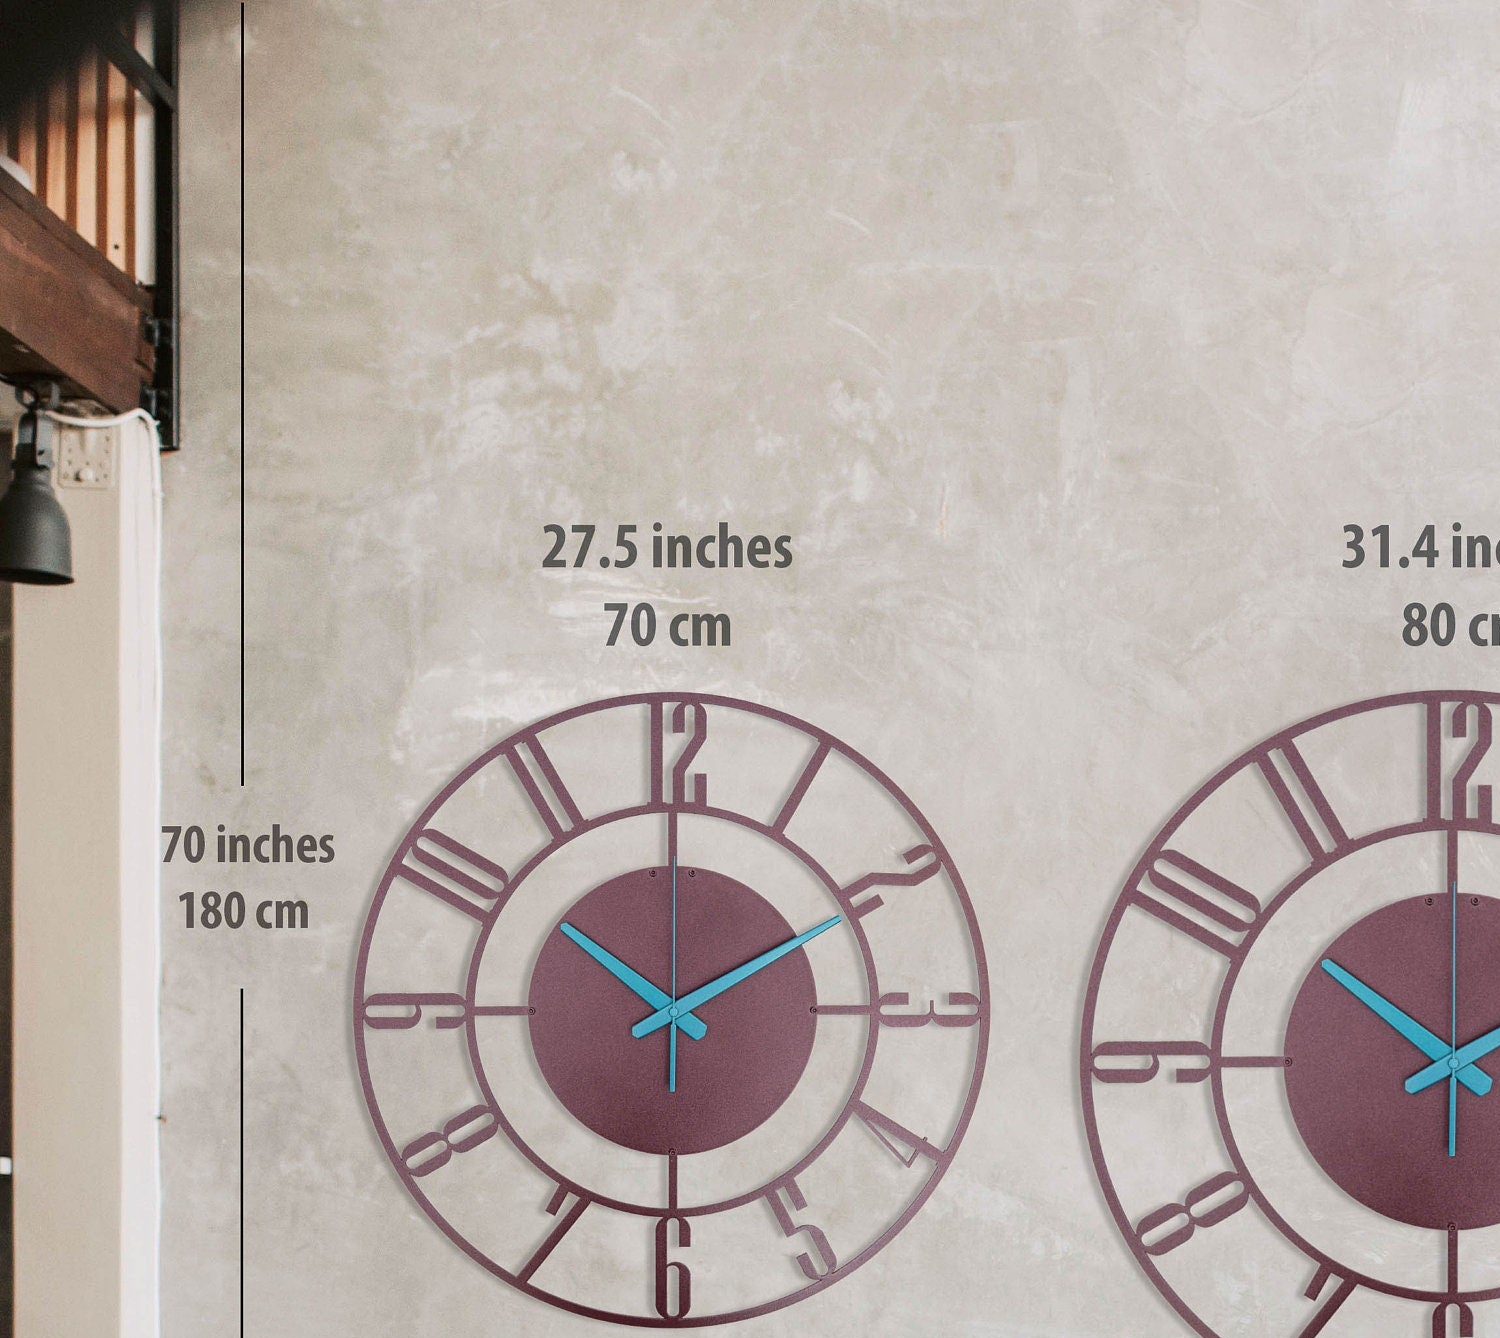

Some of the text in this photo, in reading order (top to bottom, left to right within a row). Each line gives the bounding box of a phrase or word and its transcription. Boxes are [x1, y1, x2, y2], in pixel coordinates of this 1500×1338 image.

[505, 737, 589, 842] 11
[650, 702, 707, 805] 12
[1256, 741, 1355, 862] 11
[1423, 702, 1493, 822] 12
[394, 828, 509, 924] 10
[843, 843, 942, 920] 2
[1128, 849, 1261, 962] 10
[364, 992, 468, 1030] 9
[878, 992, 981, 1028] 3
[1091, 1041, 1211, 1083] 9
[401, 1104, 499, 1177] 8
[851, 1098, 947, 1169] 4
[518, 1182, 591, 1284] 7
[764, 1179, 837, 1281] 5
[1135, 1171, 1250, 1256] 8
[655, 1217, 691, 1319] 6
